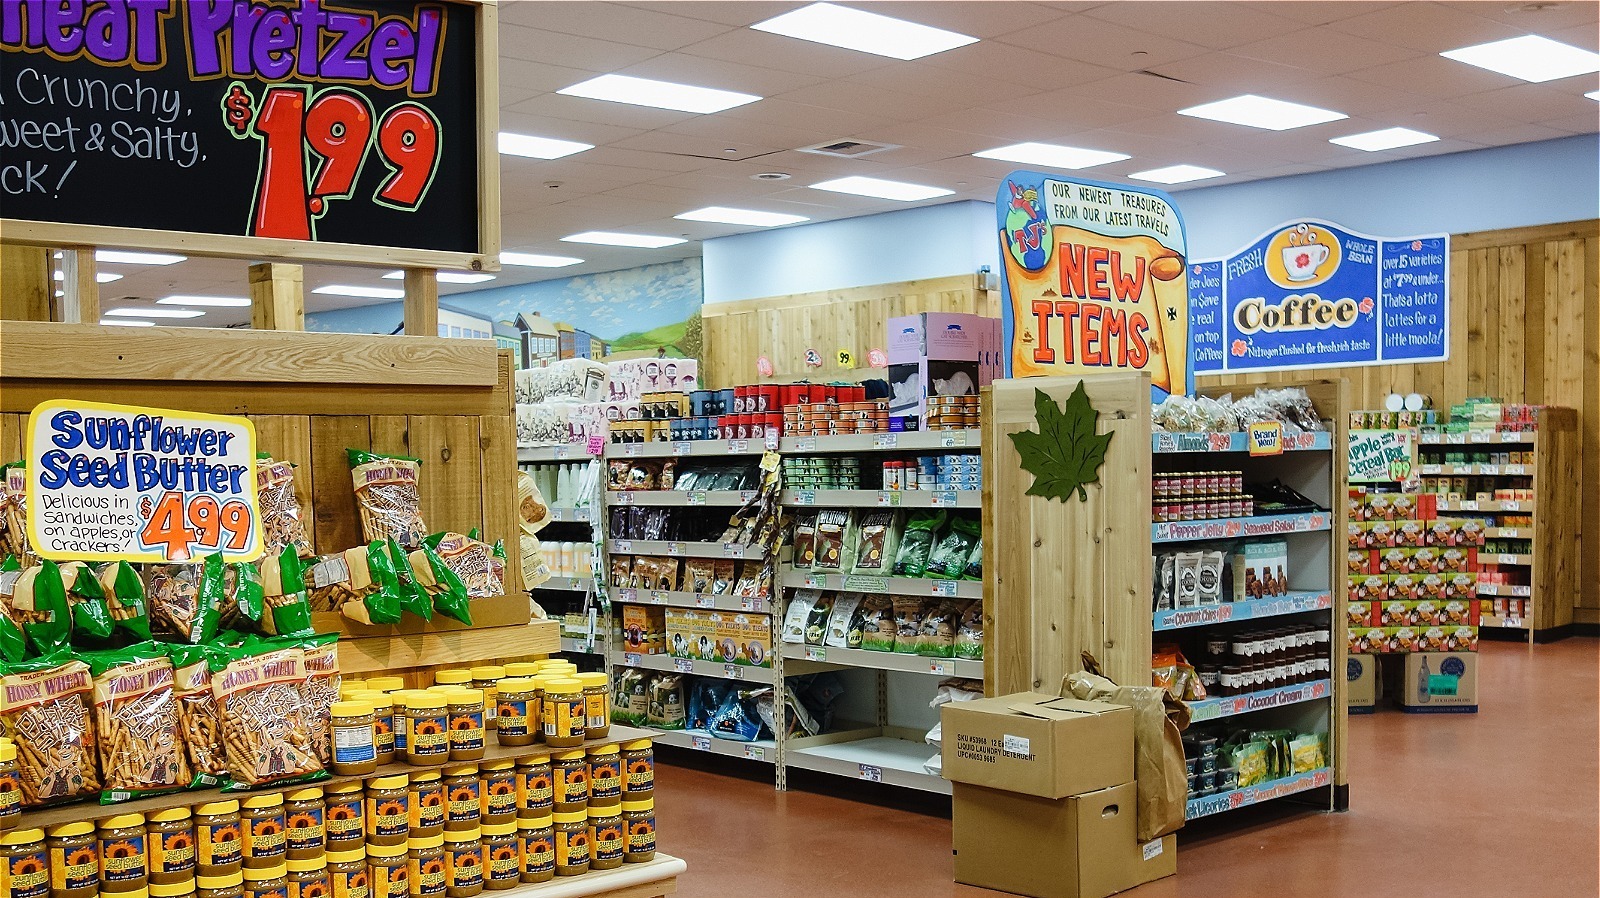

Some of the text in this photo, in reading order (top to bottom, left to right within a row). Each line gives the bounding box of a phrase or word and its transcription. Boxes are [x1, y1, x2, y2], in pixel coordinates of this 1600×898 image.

[190, 0, 445, 96] Pretzel
[16, 67, 193, 122] Crunchy,
[85, 123, 106, 152] &
[110, 121, 208, 168] Salty,
[1052, 183, 1166, 218] OUR NEWEST TREASURES
[1054, 203, 1169, 238] FROM OUR LATEST TRAVELS
[1345, 239, 1375, 255] WHOLE
[1347, 253, 1373, 265] BEAN
[1059, 241, 1147, 303] NEW
[1228, 248, 1357, 332] FRESH Coffee
[1415, 291, 1438, 306] lotta
[1197, 311, 1214, 326] real
[1385, 312, 1413, 328] lattes
[1032, 300, 1151, 369] ITEMS
[1385, 332, 1407, 348] little
[50, 409, 235, 457] Sunflower
[1254, 429, 1277, 440] Brand
[1177, 433, 1209, 452] Almonds
[41, 449, 247, 494] Seed Butter
[42, 493, 129, 511] Delicious in
[43, 526, 65, 536] on
[1169, 522, 1223, 539] Pepper Jelly
[1244, 520, 1274, 535] Seaweed
[1274, 518, 1295, 532] Salad
[1175, 608, 1201, 627] Coconut
[1201, 607, 1216, 622] Chips
[263, 660, 297, 679] WHEAT
[6, 671, 88, 704] HONEY WHEAT
[1248, 695, 1278, 710] Coconut
[957, 733, 969, 742] SKU
[991, 739, 997, 747] 12
[957, 742, 974, 751] LIQUID
[976, 745, 1002, 756] LAUNDRY
